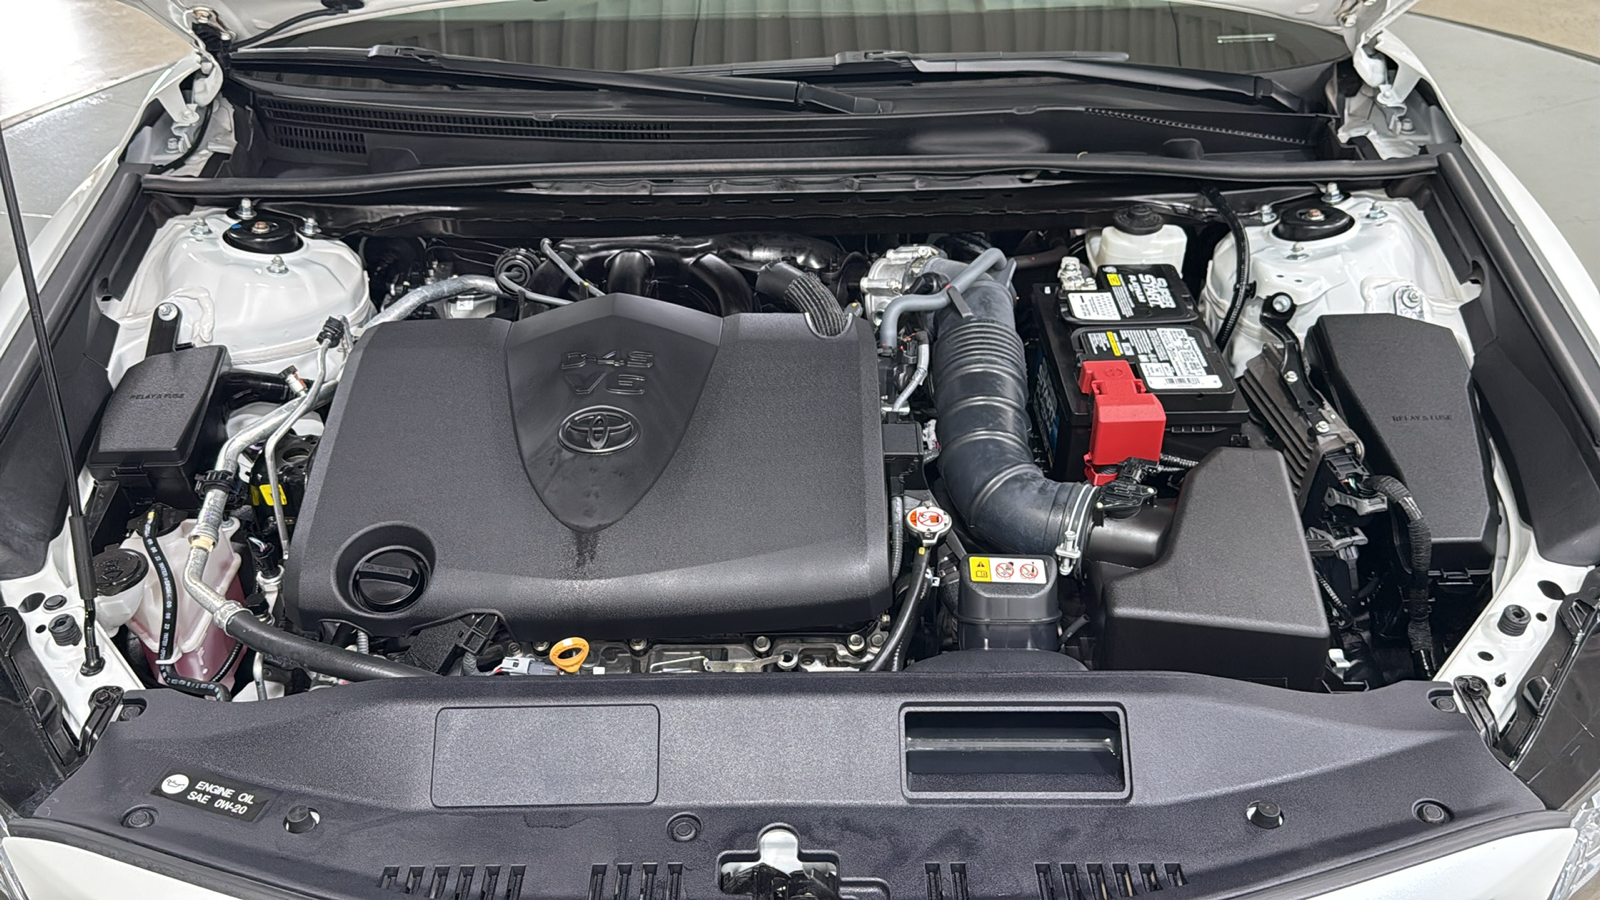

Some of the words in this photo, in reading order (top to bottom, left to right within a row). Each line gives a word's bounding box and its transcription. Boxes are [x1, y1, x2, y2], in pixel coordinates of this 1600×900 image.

[1127, 274, 1147, 303] PLATINUM
[1138, 273, 1161, 309] START
[1153, 277, 1177, 309] SUPER
[561, 350, 654, 369] D-4S
[563, 372, 646, 395] V6
[186, 791, 211, 804] SAE
[213, 799, 248, 814] 0W-20
[195, 780, 236, 798] ENGINE
[237, 792, 255, 804] OIL
